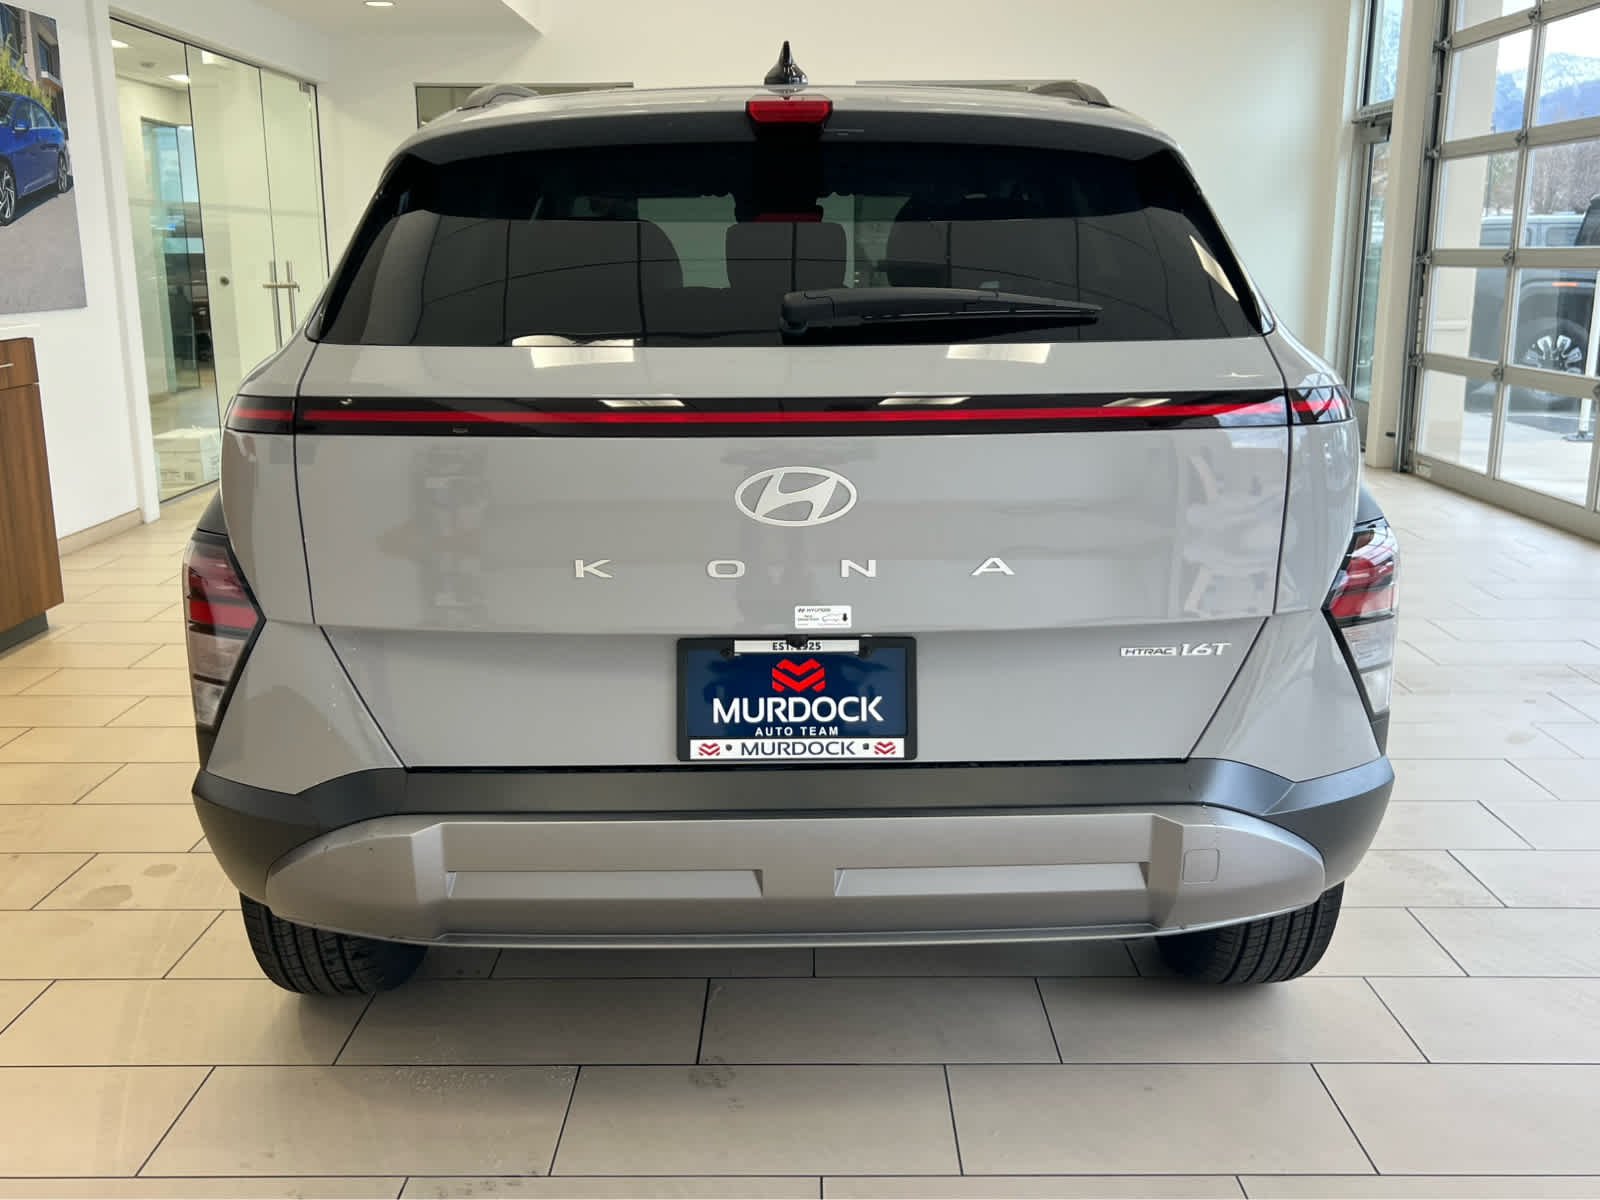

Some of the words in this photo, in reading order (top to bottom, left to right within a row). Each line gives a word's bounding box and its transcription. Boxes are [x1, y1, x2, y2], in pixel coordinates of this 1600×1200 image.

[575, 557, 1015, 578] KONA
[796, 641, 822, 651] 925
[1124, 647, 1174, 656] HTRAC
[712, 695, 884, 724] MURDOCK
[754, 726, 793, 737] AUTO
[800, 725, 839, 736] TEAM
[740, 740, 856, 756] MURDOCK
